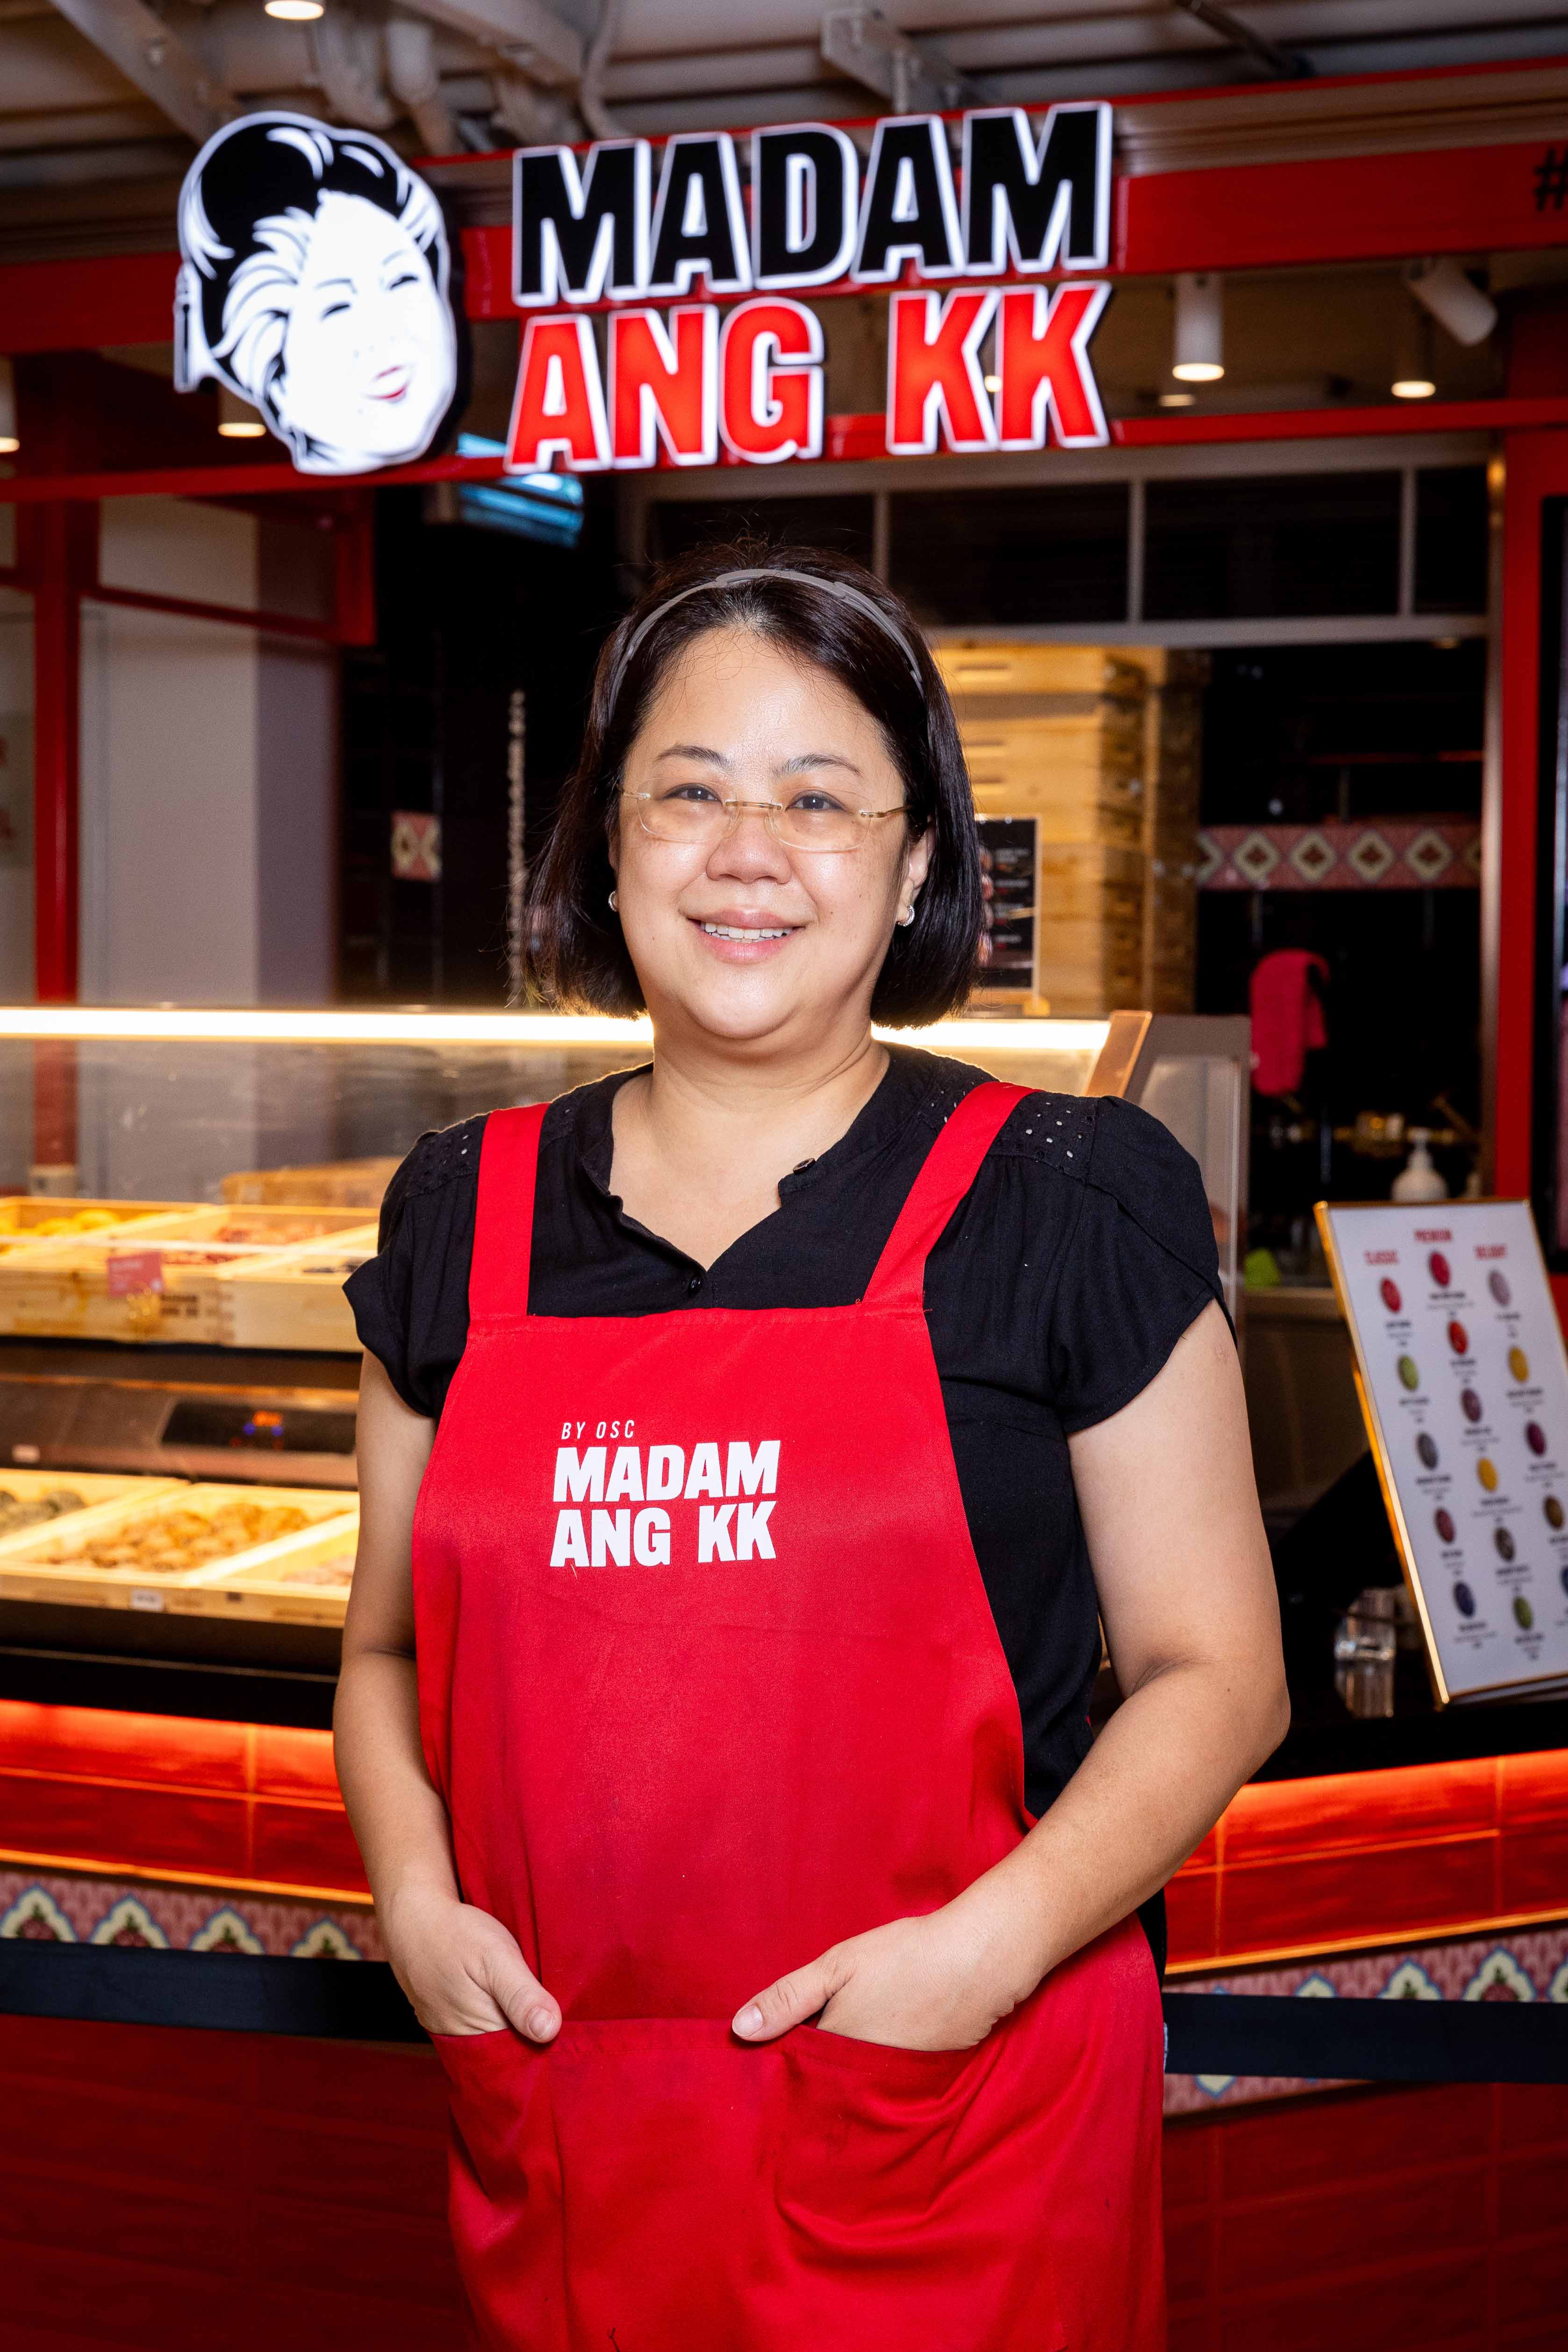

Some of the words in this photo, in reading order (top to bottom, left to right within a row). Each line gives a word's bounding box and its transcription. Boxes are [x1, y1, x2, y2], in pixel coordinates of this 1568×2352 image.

[512, 101, 1113, 307] MADAM
[503, 297, 825, 473] ANG
[886, 280, 1113, 455] KK
[561, 1421, 586, 1440] BY
[596, 1420, 635, 1439] OSC
[553, 1440, 781, 1503] MADAM
[550, 1506, 671, 1567] ANG
[698, 1500, 777, 1563] KK
